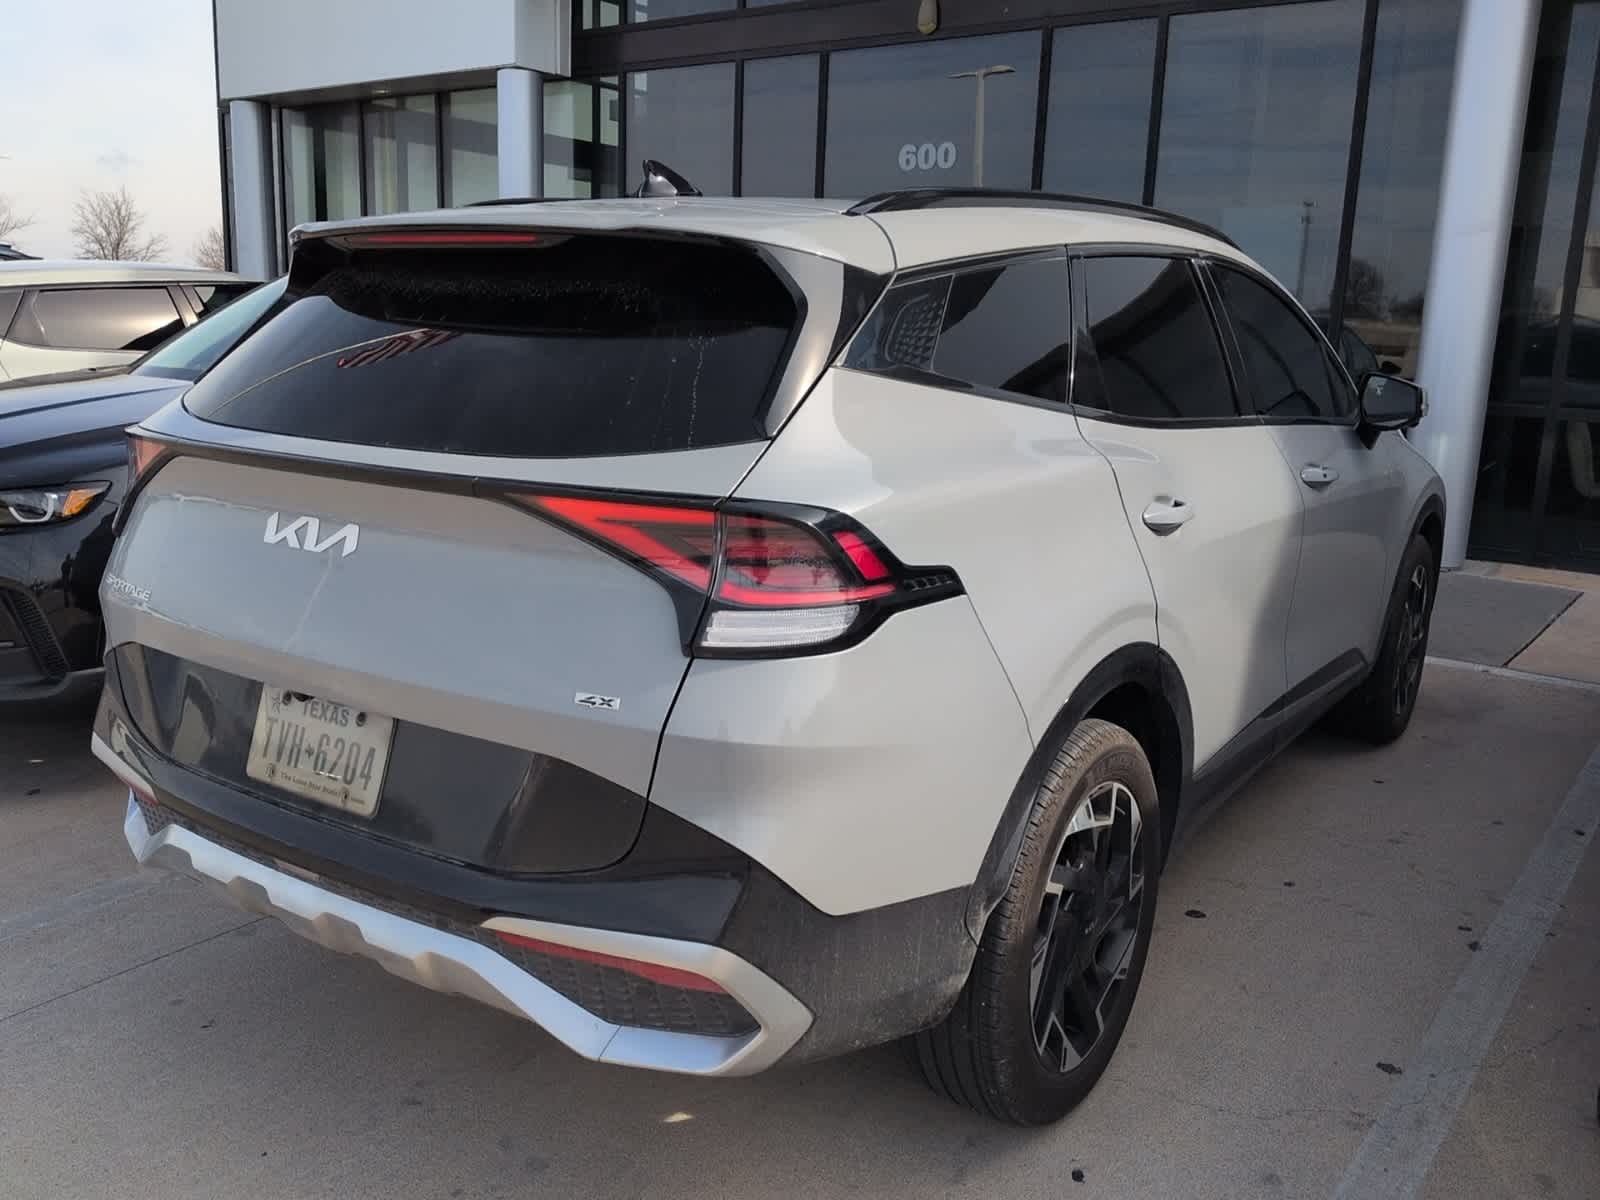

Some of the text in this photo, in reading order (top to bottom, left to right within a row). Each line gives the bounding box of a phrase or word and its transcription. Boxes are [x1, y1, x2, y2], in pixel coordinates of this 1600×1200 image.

[898, 142, 957, 171] 600
[263, 512, 360, 557] KIA
[303, 700, 350, 727] TEXAS
